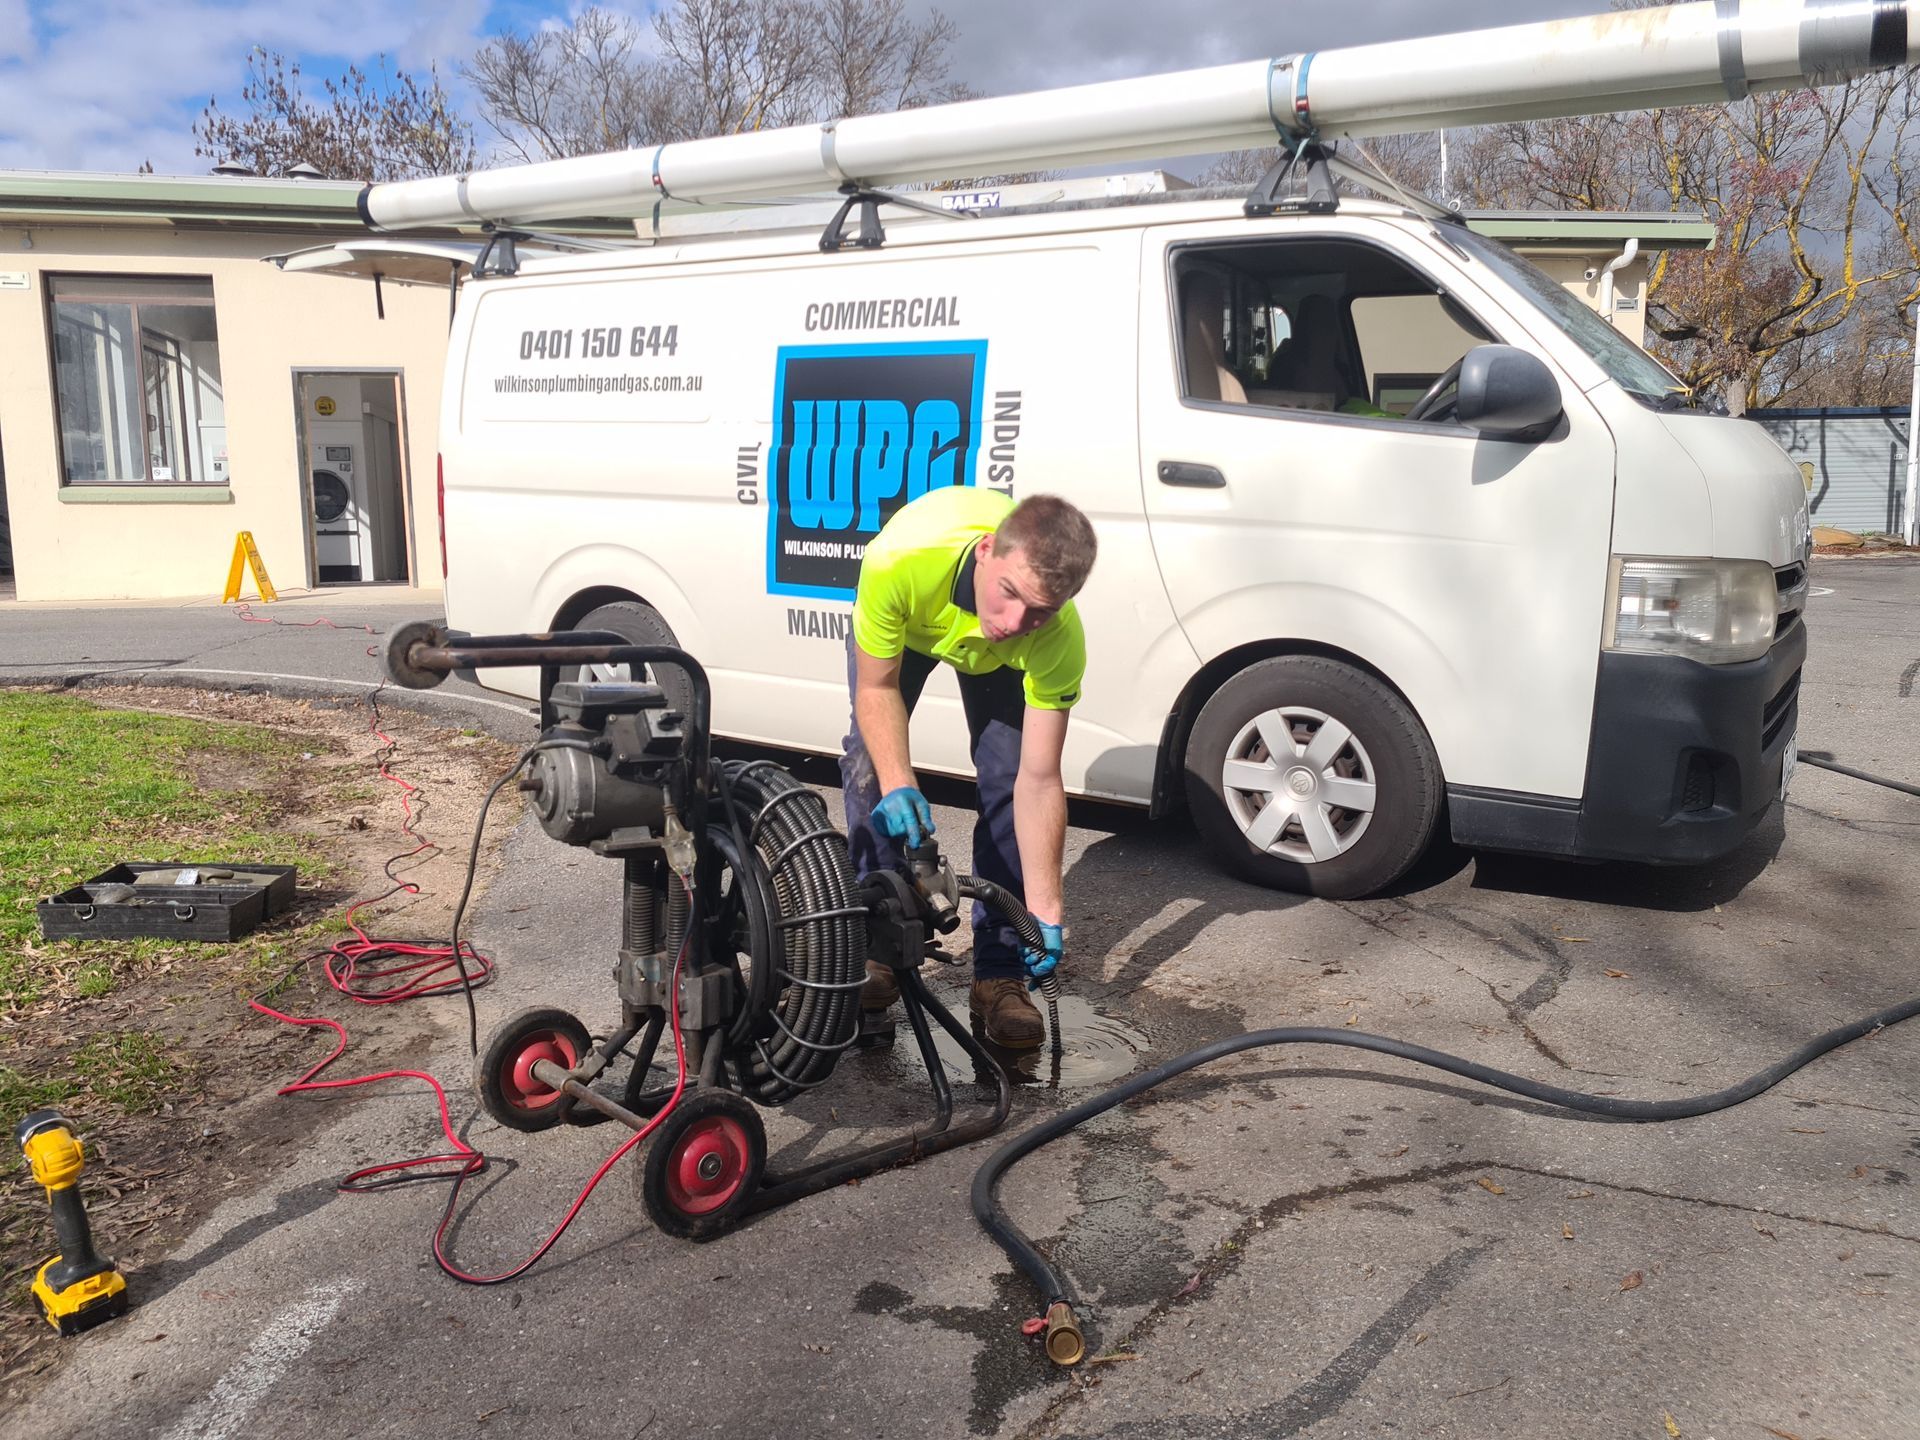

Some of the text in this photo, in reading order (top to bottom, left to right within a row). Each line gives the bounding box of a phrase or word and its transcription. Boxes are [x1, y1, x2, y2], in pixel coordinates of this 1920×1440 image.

[942, 192, 999, 210] BAILEY
[804, 296, 960, 332] COMMERCIAL
[519, 325, 678, 360] 0401 150 644
[494, 373, 703, 395] wilkinsonplumbingandgas.com.au
[737, 441, 762, 505] CIVIL
[789, 400, 961, 532] WPG
[784, 540, 842, 558] WILKINSON
